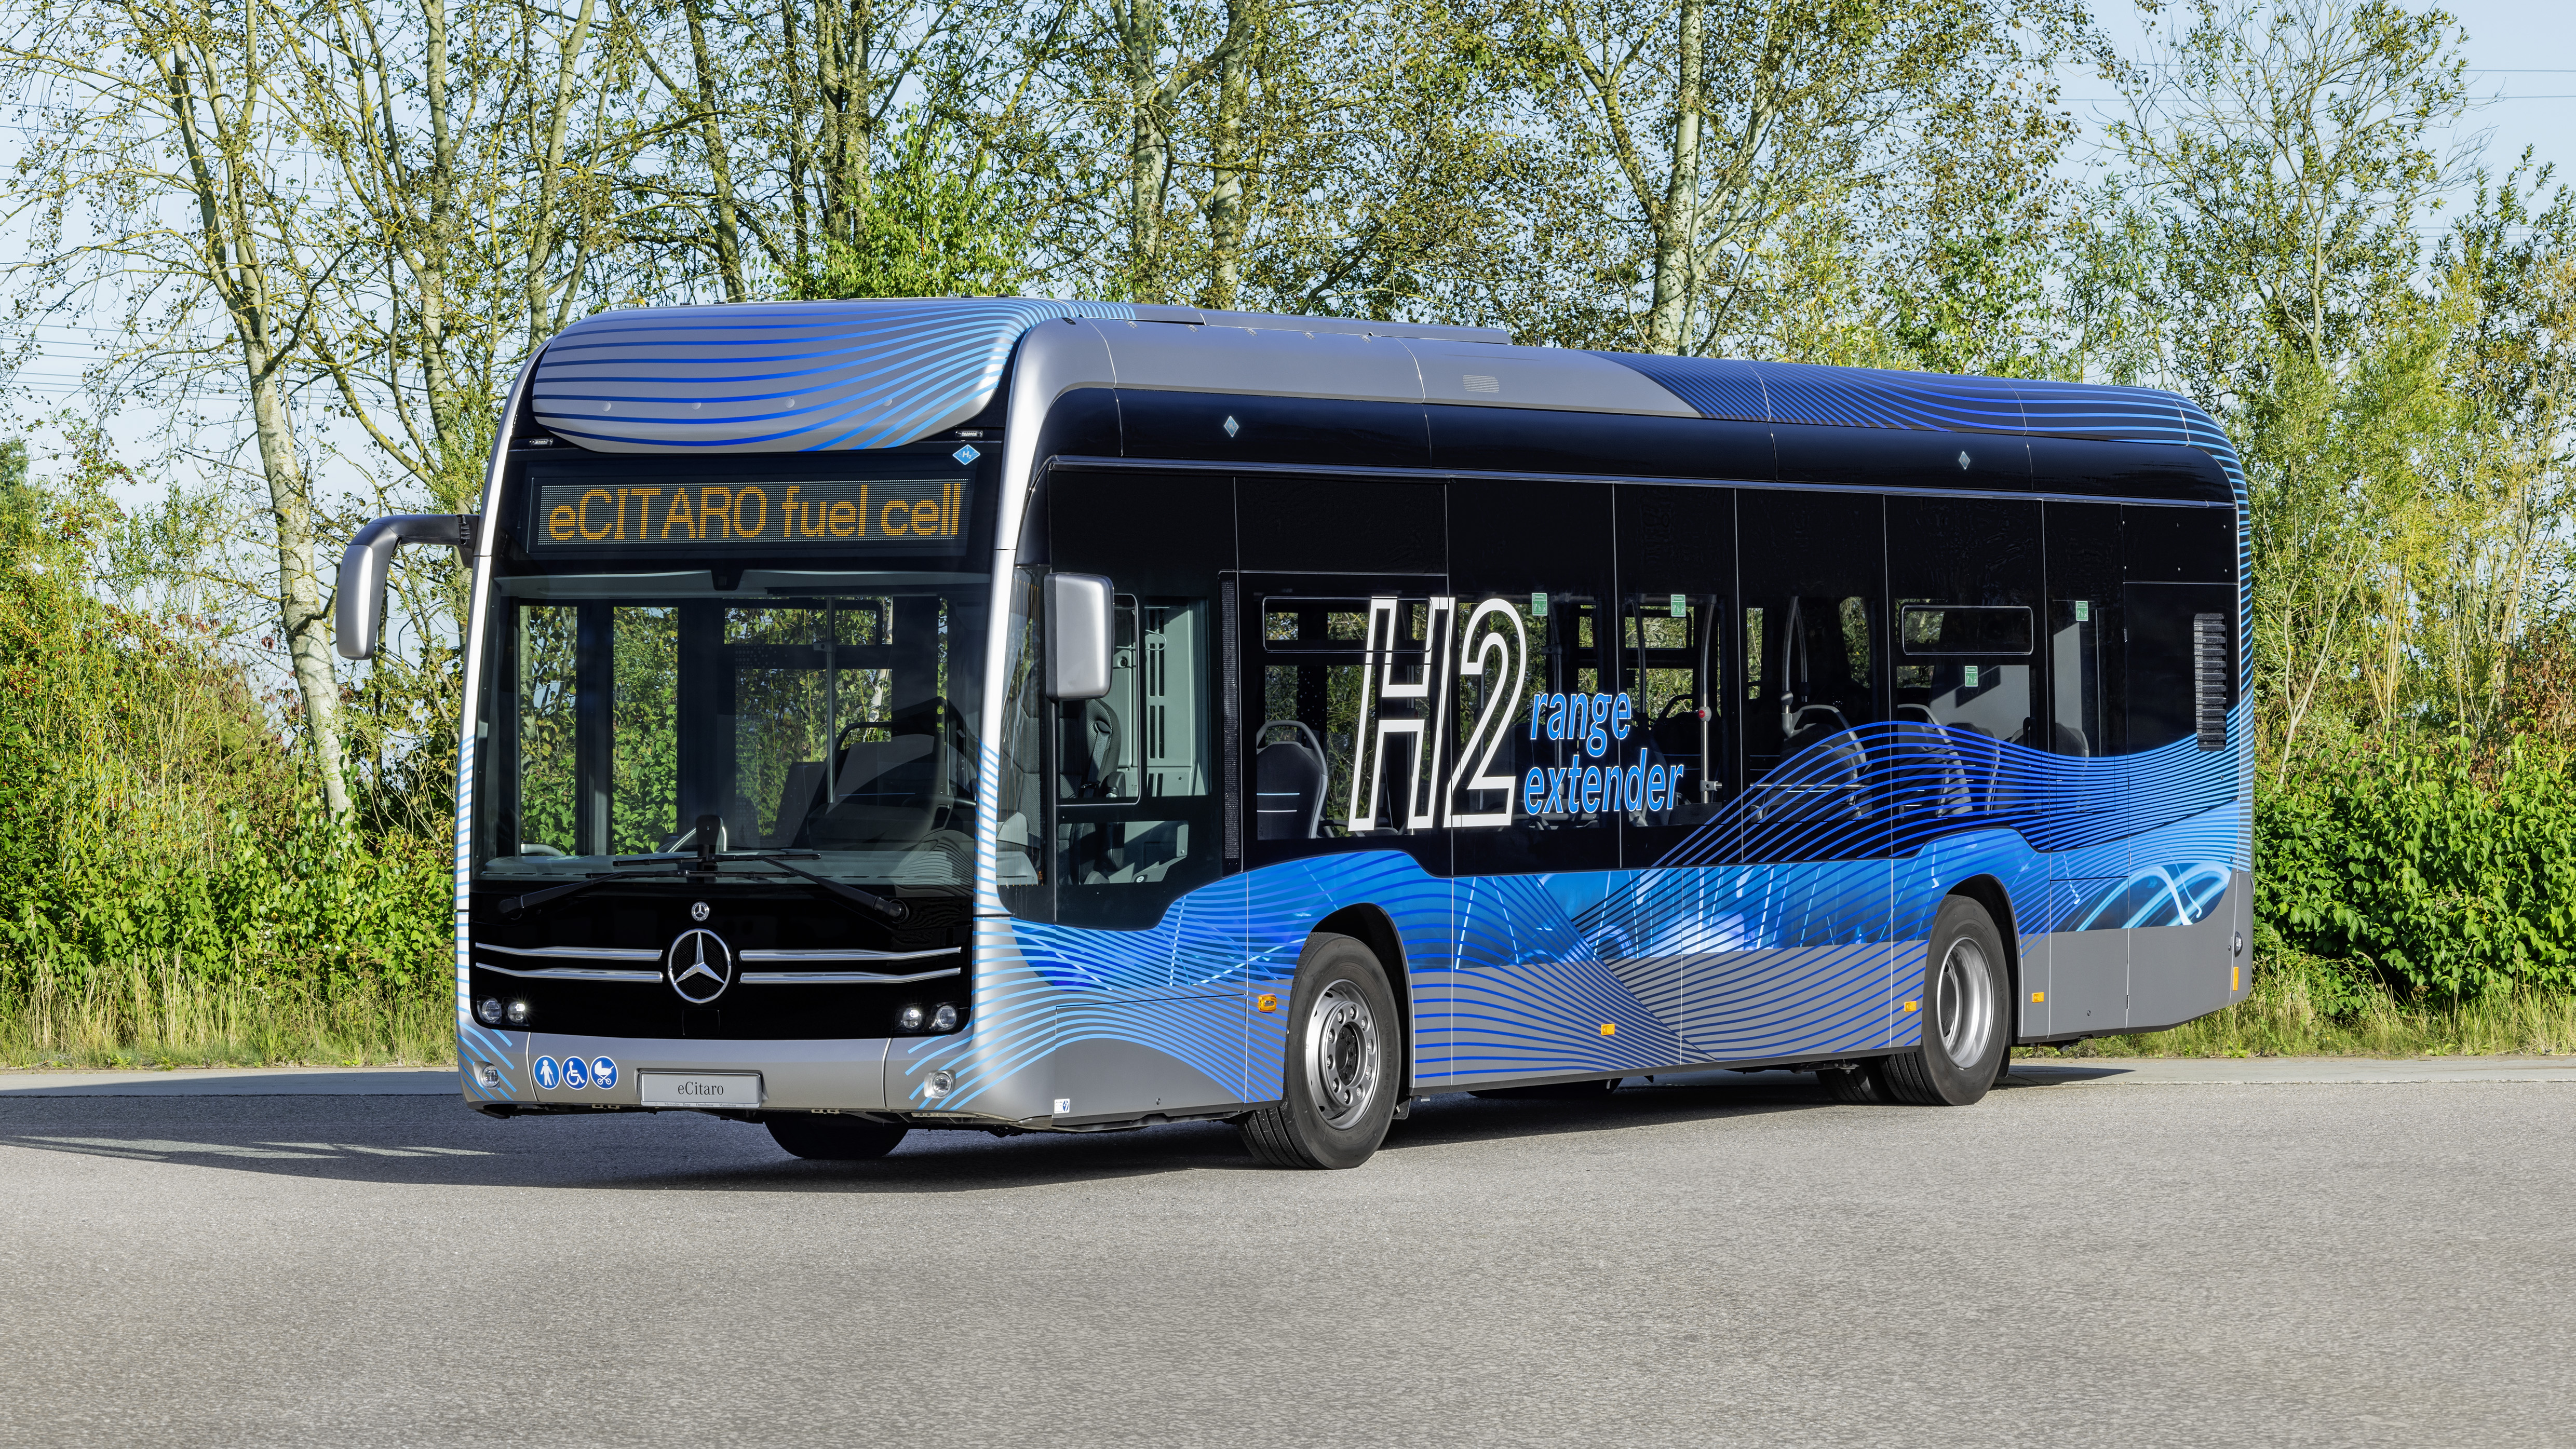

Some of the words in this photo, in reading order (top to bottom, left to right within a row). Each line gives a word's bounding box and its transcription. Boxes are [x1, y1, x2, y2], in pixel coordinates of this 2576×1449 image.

[962, 451, 972, 459] H2
[549, 486, 767, 540] eCITARO
[781, 484, 868, 537] fuel
[881, 483, 961, 536] cell
[1348, 596, 1527, 832] H2
[1531, 692, 1632, 757] range
[1523, 748, 1684, 815] extender
[678, 1081, 724, 1095] eCitaro
